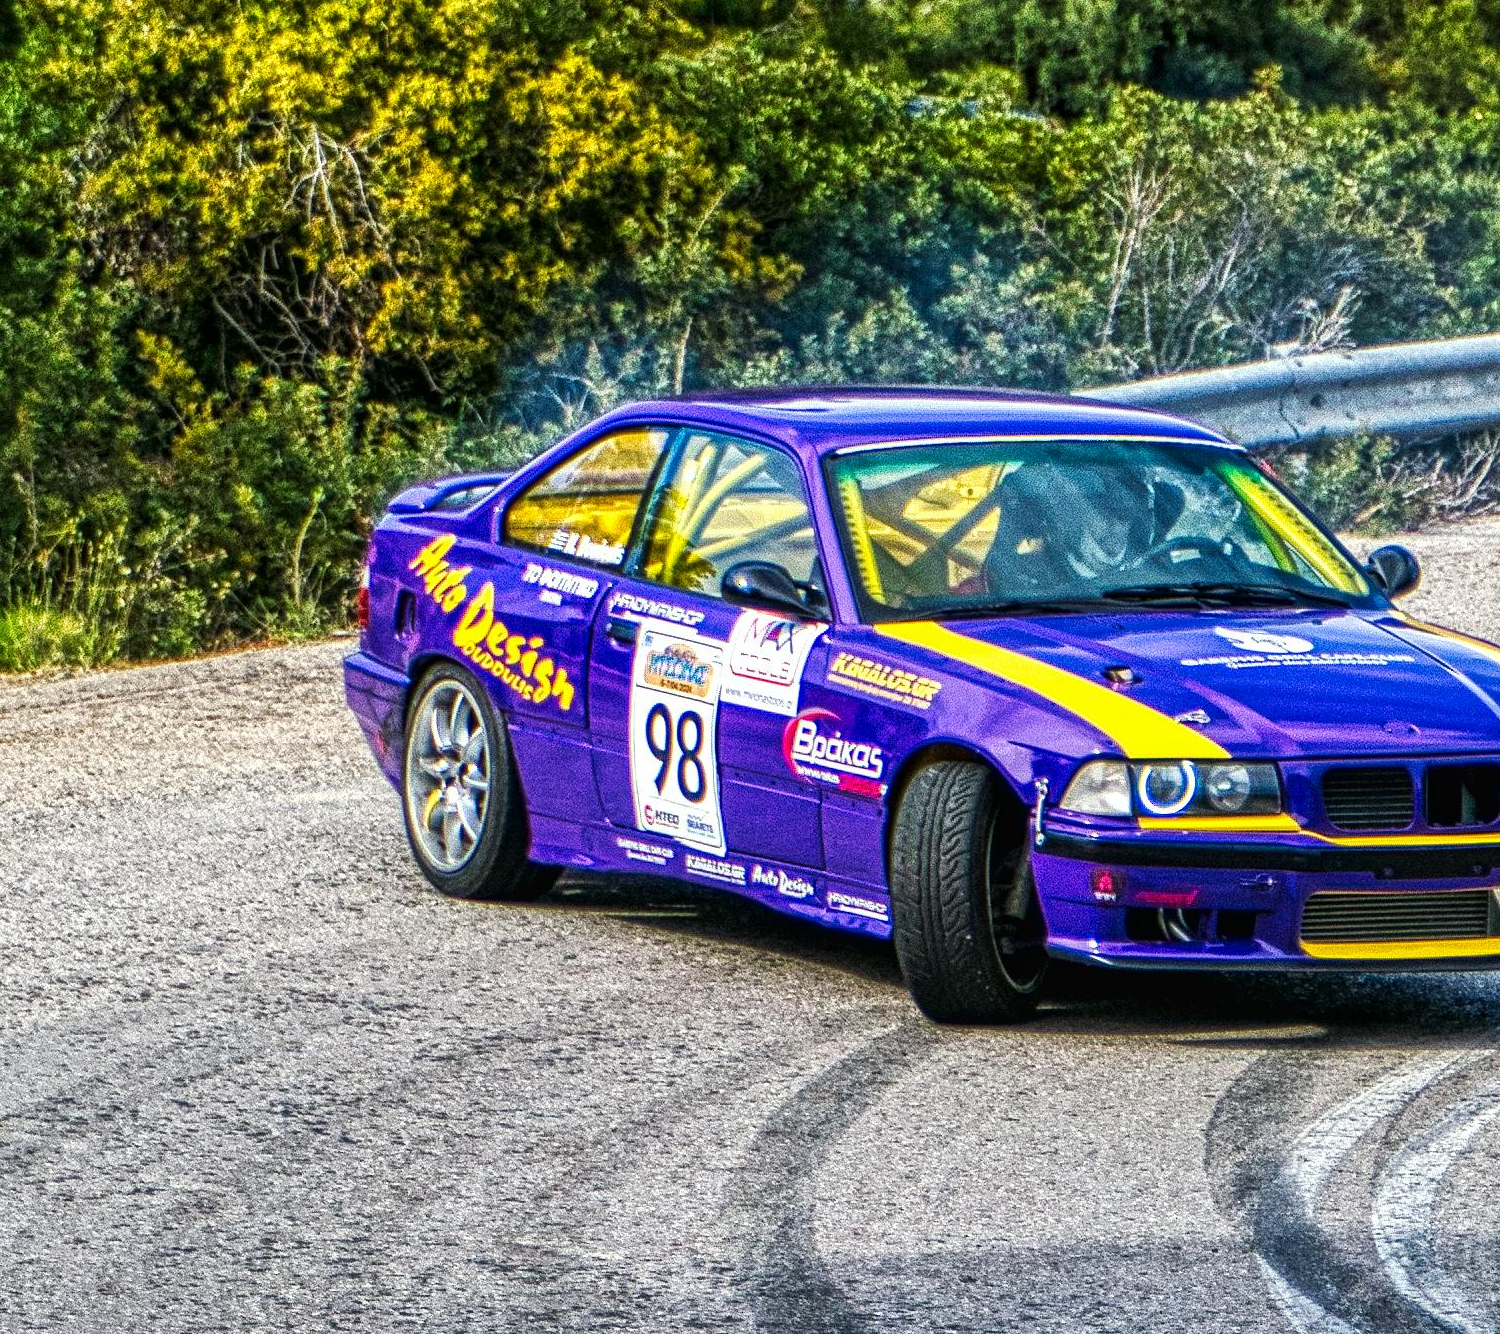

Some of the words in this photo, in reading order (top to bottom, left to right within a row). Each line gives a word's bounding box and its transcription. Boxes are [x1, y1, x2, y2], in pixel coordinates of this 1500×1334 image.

[408, 533, 473, 613] Auto
[453, 581, 575, 711] Design
[646, 702, 708, 804] 98
[752, 864, 779, 887] Auto
